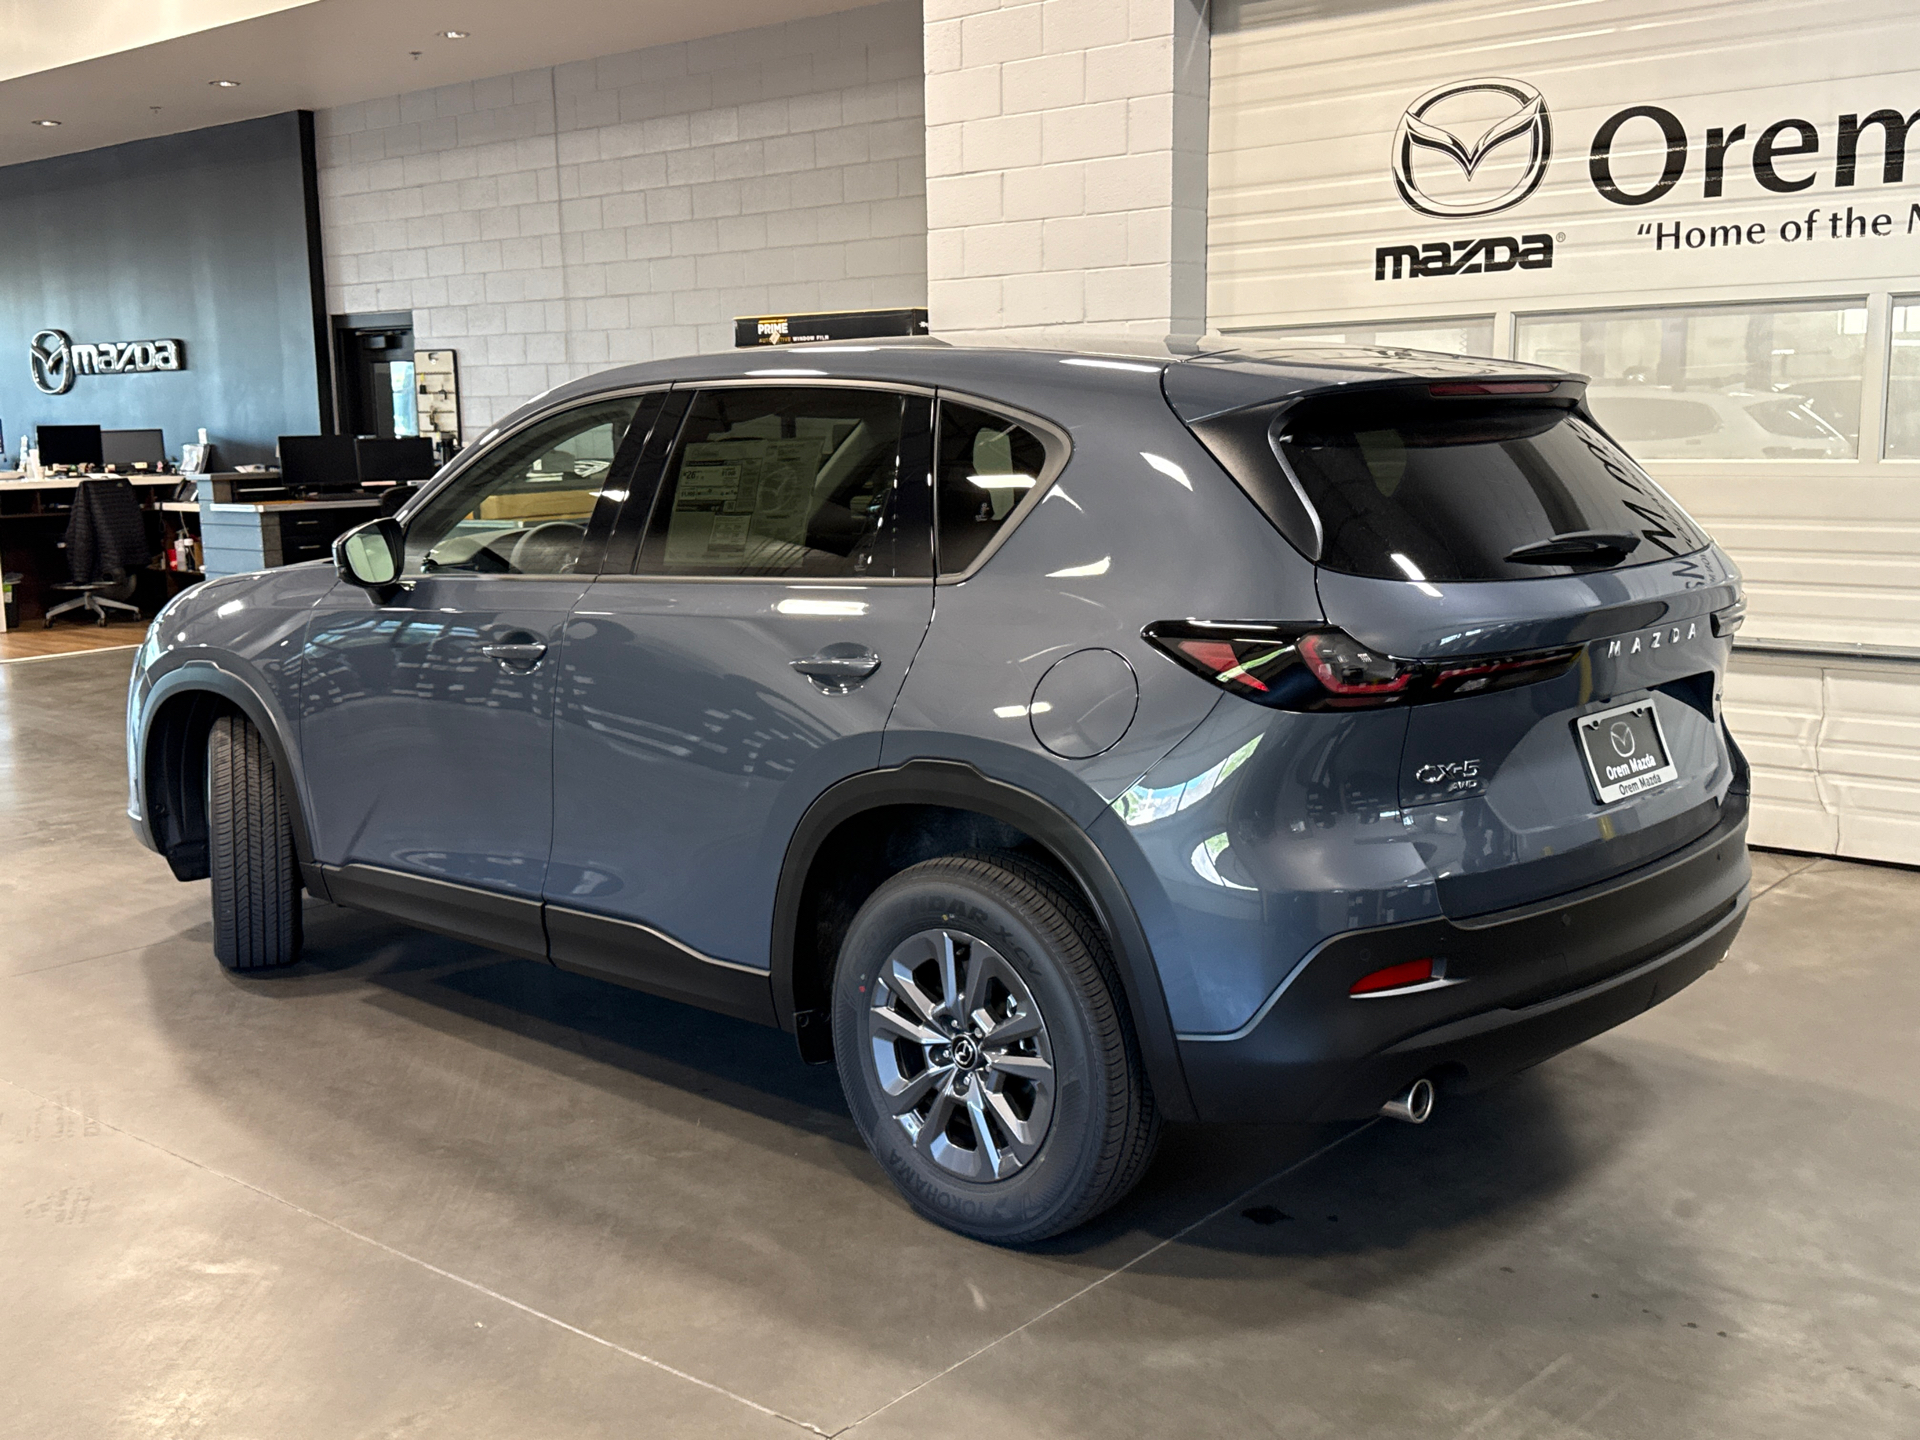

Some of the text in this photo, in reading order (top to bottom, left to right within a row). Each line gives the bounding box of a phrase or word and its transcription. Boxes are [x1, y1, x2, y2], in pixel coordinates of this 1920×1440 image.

[1588, 105, 1920, 206] Orem
[1779, 208, 1820, 242] of
[1828, 206, 1892, 239] the
[757, 323, 788, 335] PRIME
[1607, 622, 1696, 659] MAZDA
[1415, 759, 1480, 783] CX-5
[1606, 753, 1657, 780] Orem Mazda
[1619, 773, 1662, 796] Orem Mazda
